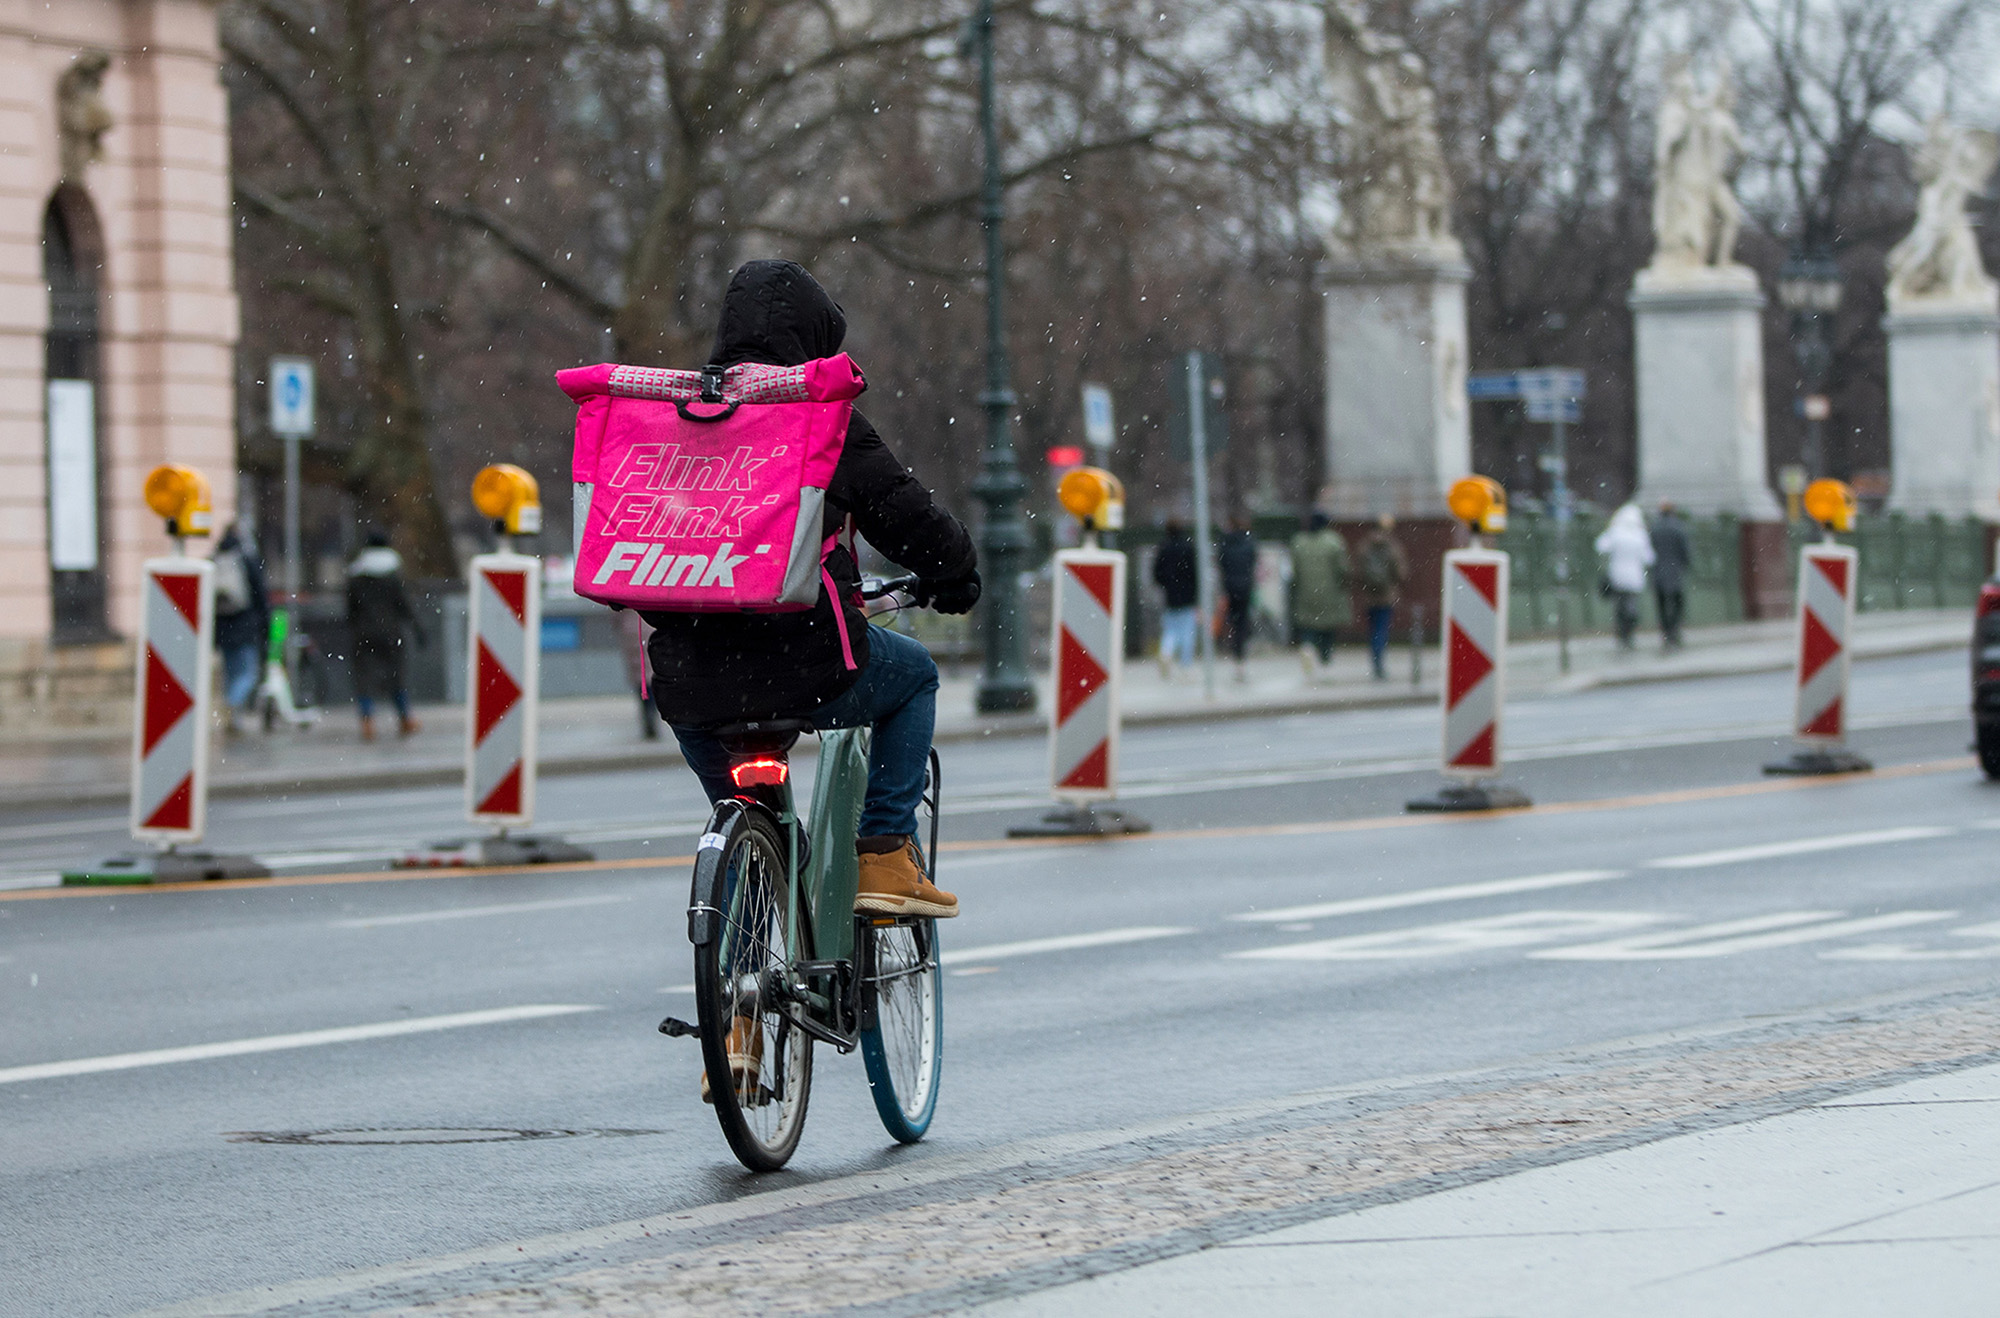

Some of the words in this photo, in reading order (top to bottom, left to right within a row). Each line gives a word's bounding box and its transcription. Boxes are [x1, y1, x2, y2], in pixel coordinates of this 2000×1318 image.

[608, 443, 768, 492] Flink
[600, 493, 759, 539] Flink
[592, 541, 750, 588] Flink
